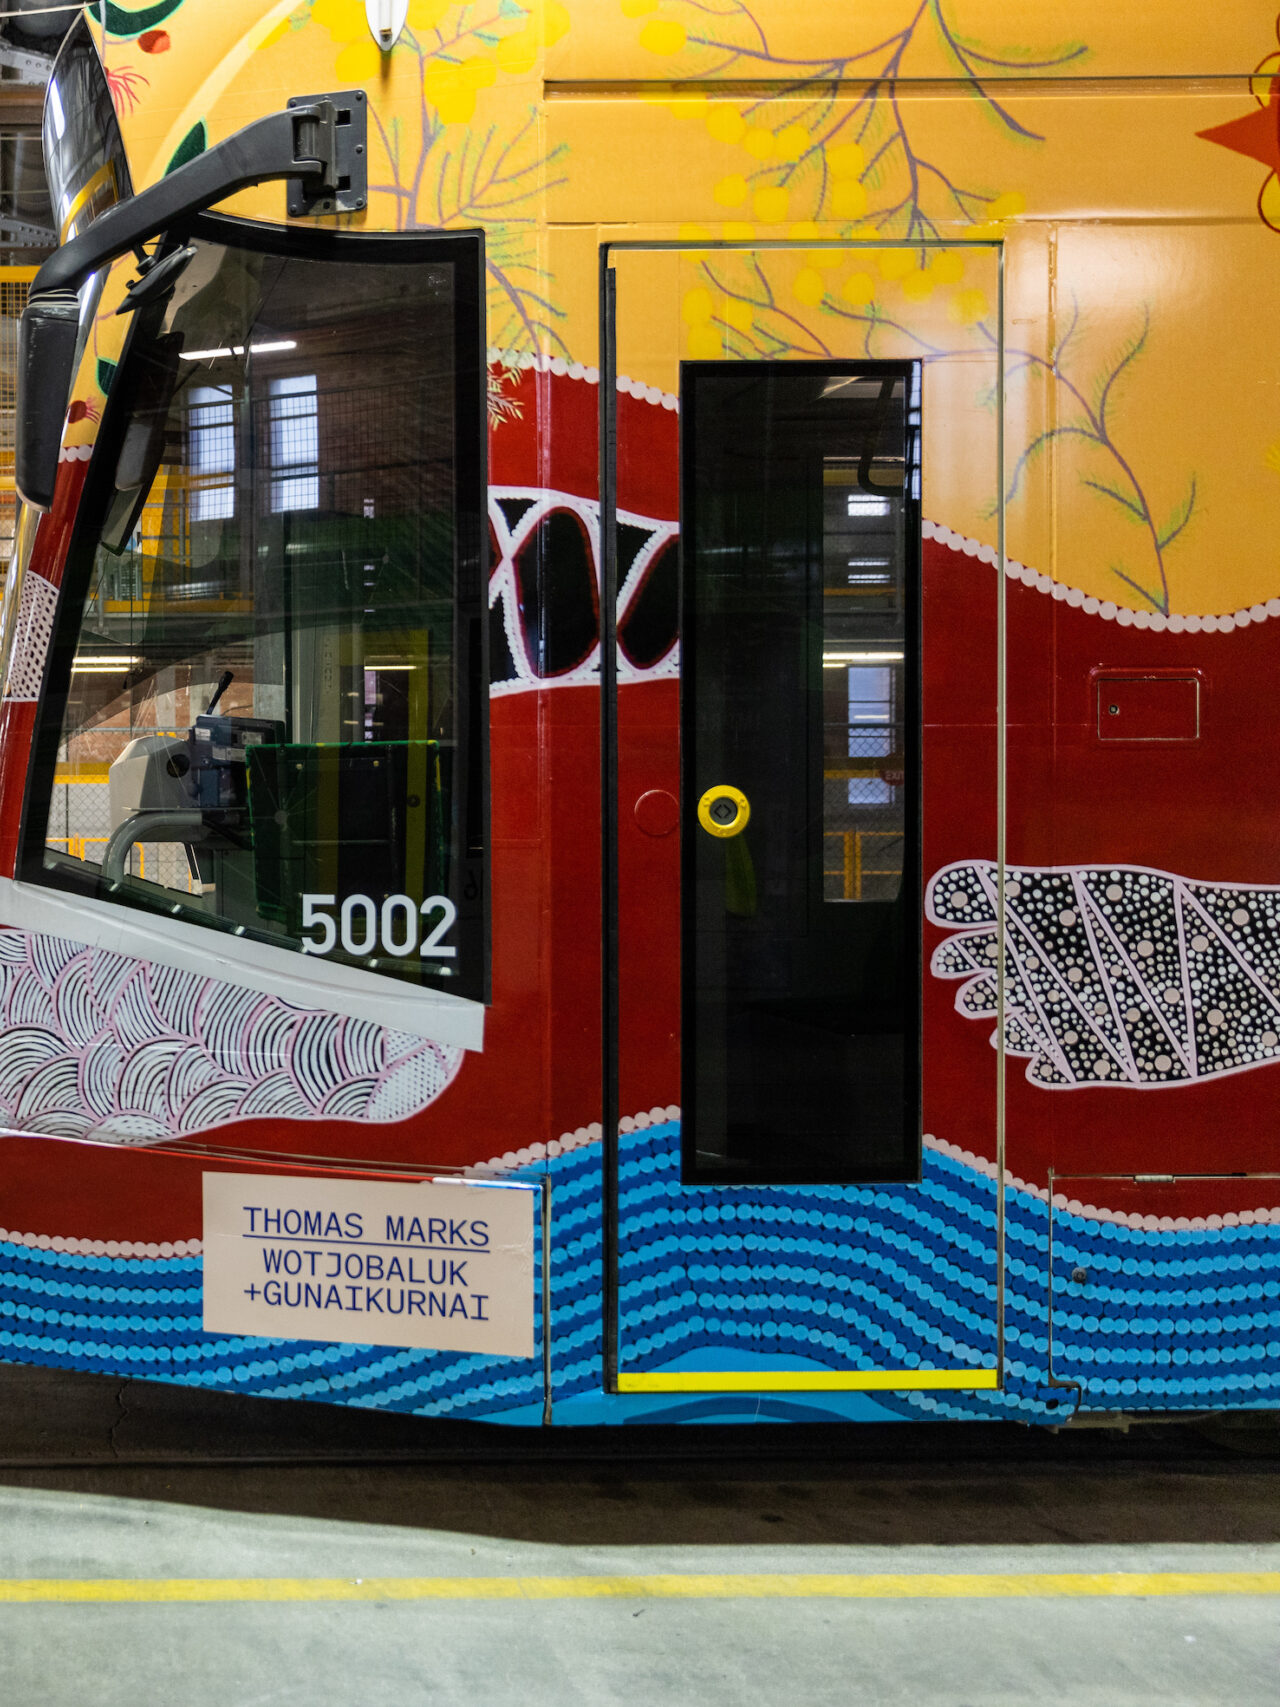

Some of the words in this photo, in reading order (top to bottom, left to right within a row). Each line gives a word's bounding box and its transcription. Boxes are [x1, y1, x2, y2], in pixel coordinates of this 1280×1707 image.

[301, 893, 457, 957] 5002
[242, 1206, 364, 1239] THOMAS
[386, 1215, 490, 1247] MARKS
[262, 1247, 469, 1288] WOTJOBALUK
[243, 1279, 489, 1321] +GUNAIKURNAI
